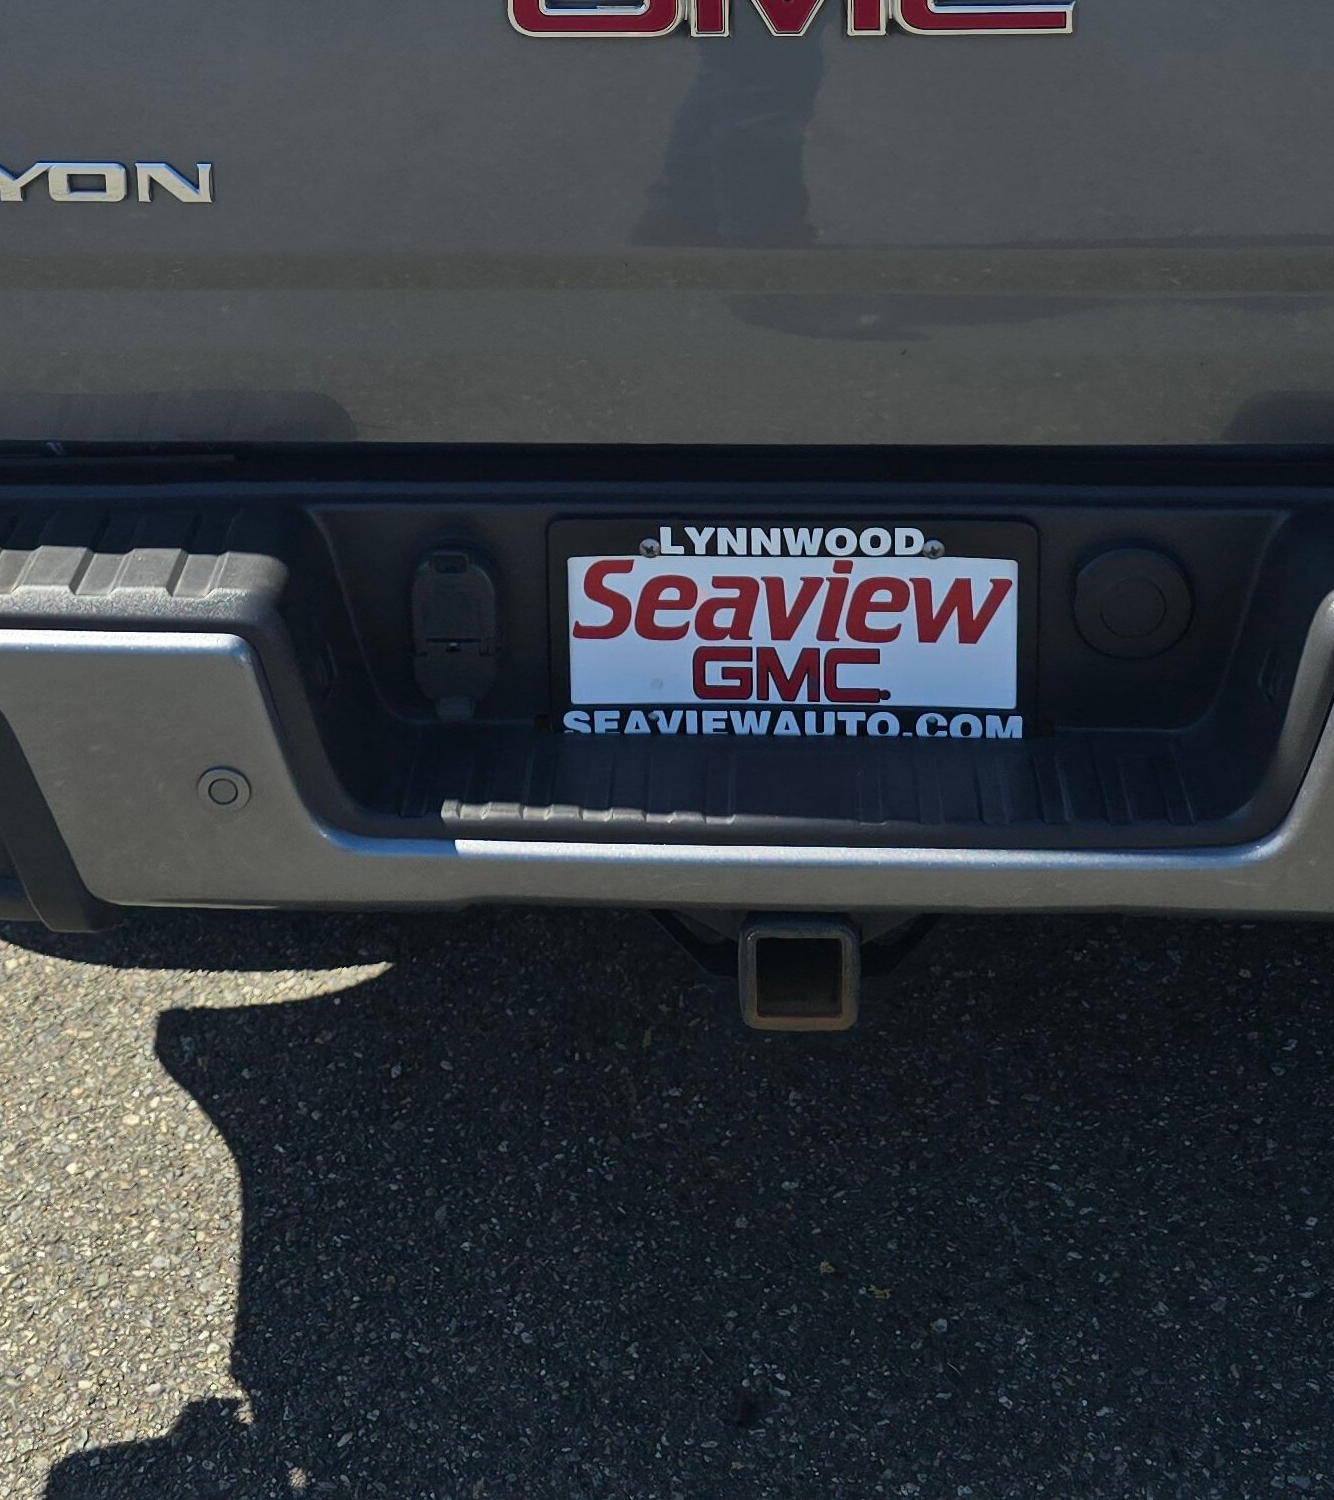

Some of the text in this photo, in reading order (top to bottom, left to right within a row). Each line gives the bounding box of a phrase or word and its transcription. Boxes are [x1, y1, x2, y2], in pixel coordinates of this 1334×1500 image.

[659, 526, 926, 556] LYNNWOOD
[572, 560, 1013, 644] Seaview
[692, 647, 881, 703] GMC
[563, 710, 1023, 739] SEAVIEWAUTO.COM
